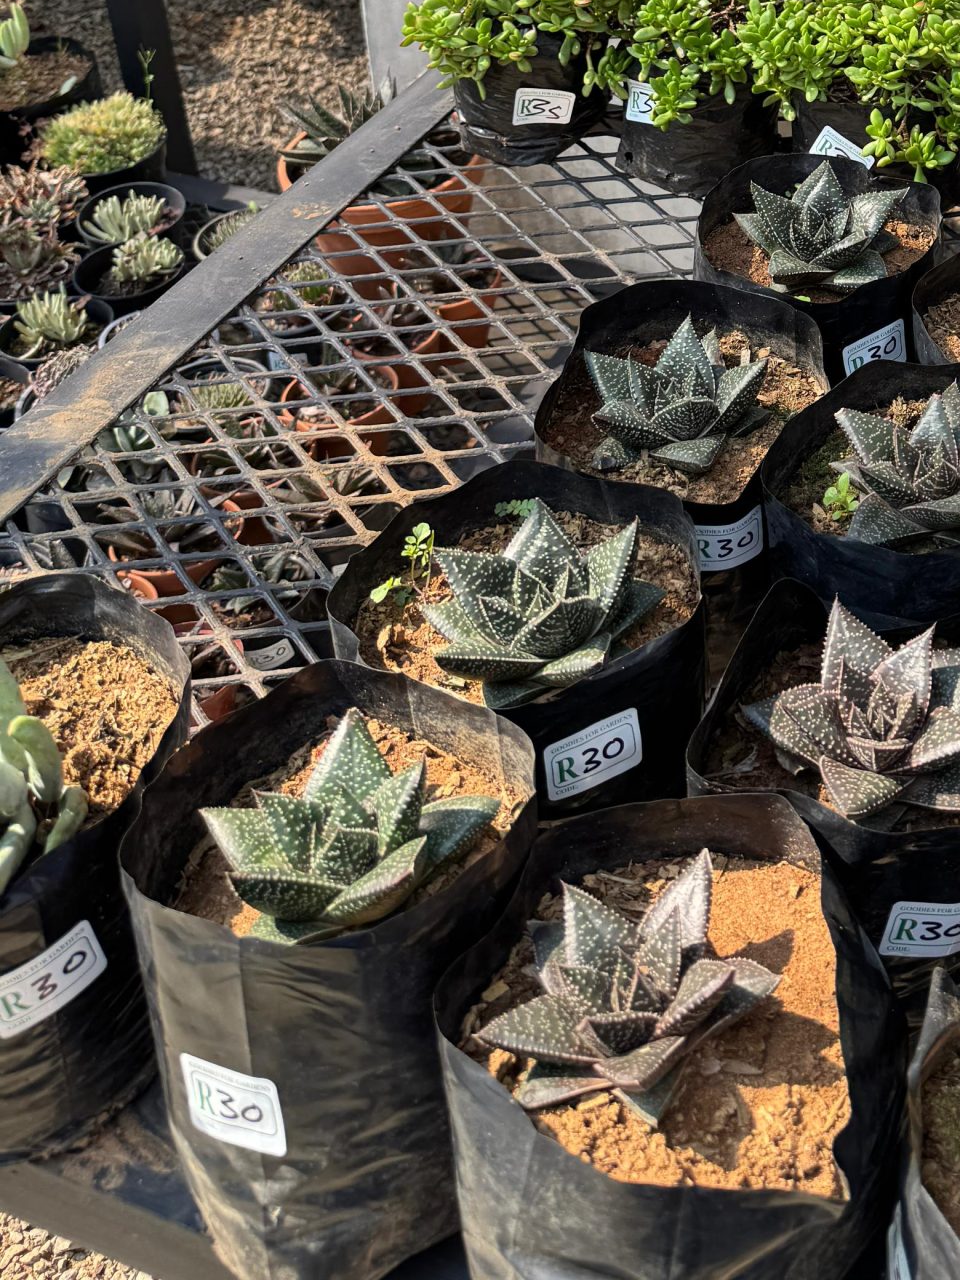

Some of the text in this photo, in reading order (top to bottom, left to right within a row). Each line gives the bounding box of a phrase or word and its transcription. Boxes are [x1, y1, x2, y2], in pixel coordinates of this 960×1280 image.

[632, 91, 658, 113] R3
[698, 531, 753, 558] R30
[551, 714, 633, 755] GOODIES FOR GARDENS
[555, 737, 625, 785] R30
[900, 905, 936, 913] GOODIES
[0, 951, 87, 1019] R30
[195, 1078, 263, 1122] R30
